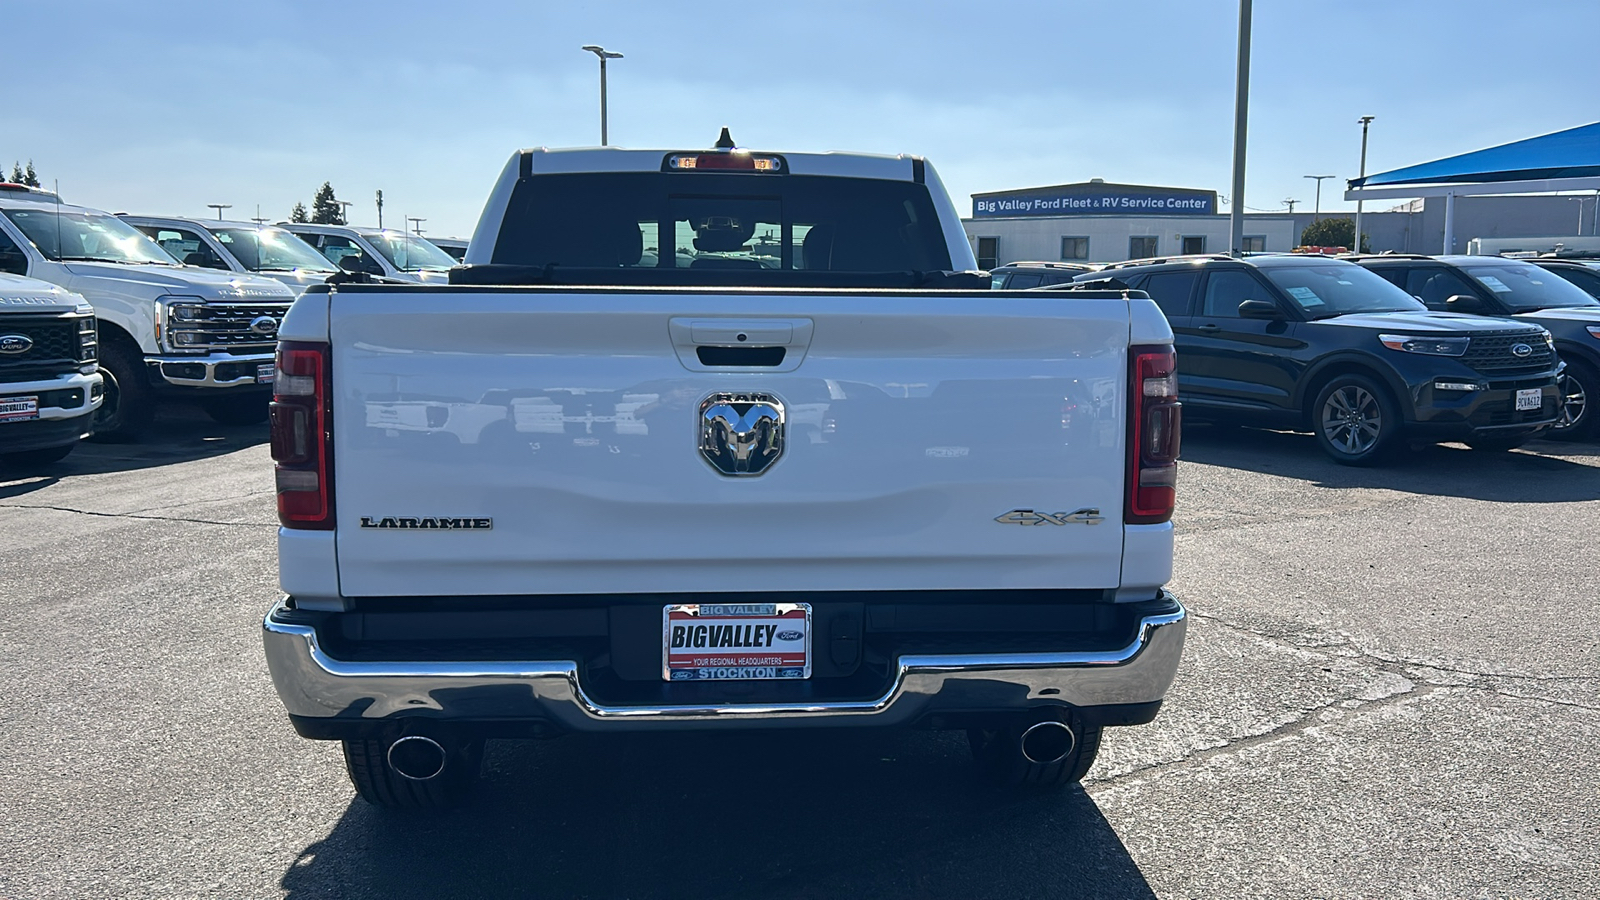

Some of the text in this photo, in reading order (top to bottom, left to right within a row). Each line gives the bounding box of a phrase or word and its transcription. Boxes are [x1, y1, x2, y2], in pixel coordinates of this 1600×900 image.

[977, 197, 1207, 212] Big Valley Ford Fleet & RV Service Center
[716, 394, 768, 402] RAM
[360, 516, 493, 530] LARAMIE
[700, 605, 775, 615] BIG VALLEY
[671, 625, 777, 648] BIGVALLEY
[781, 632, 799, 640] Ford
[738, 657, 782, 665] HEADQUARTERS
[699, 668, 776, 678] STOCKTON
